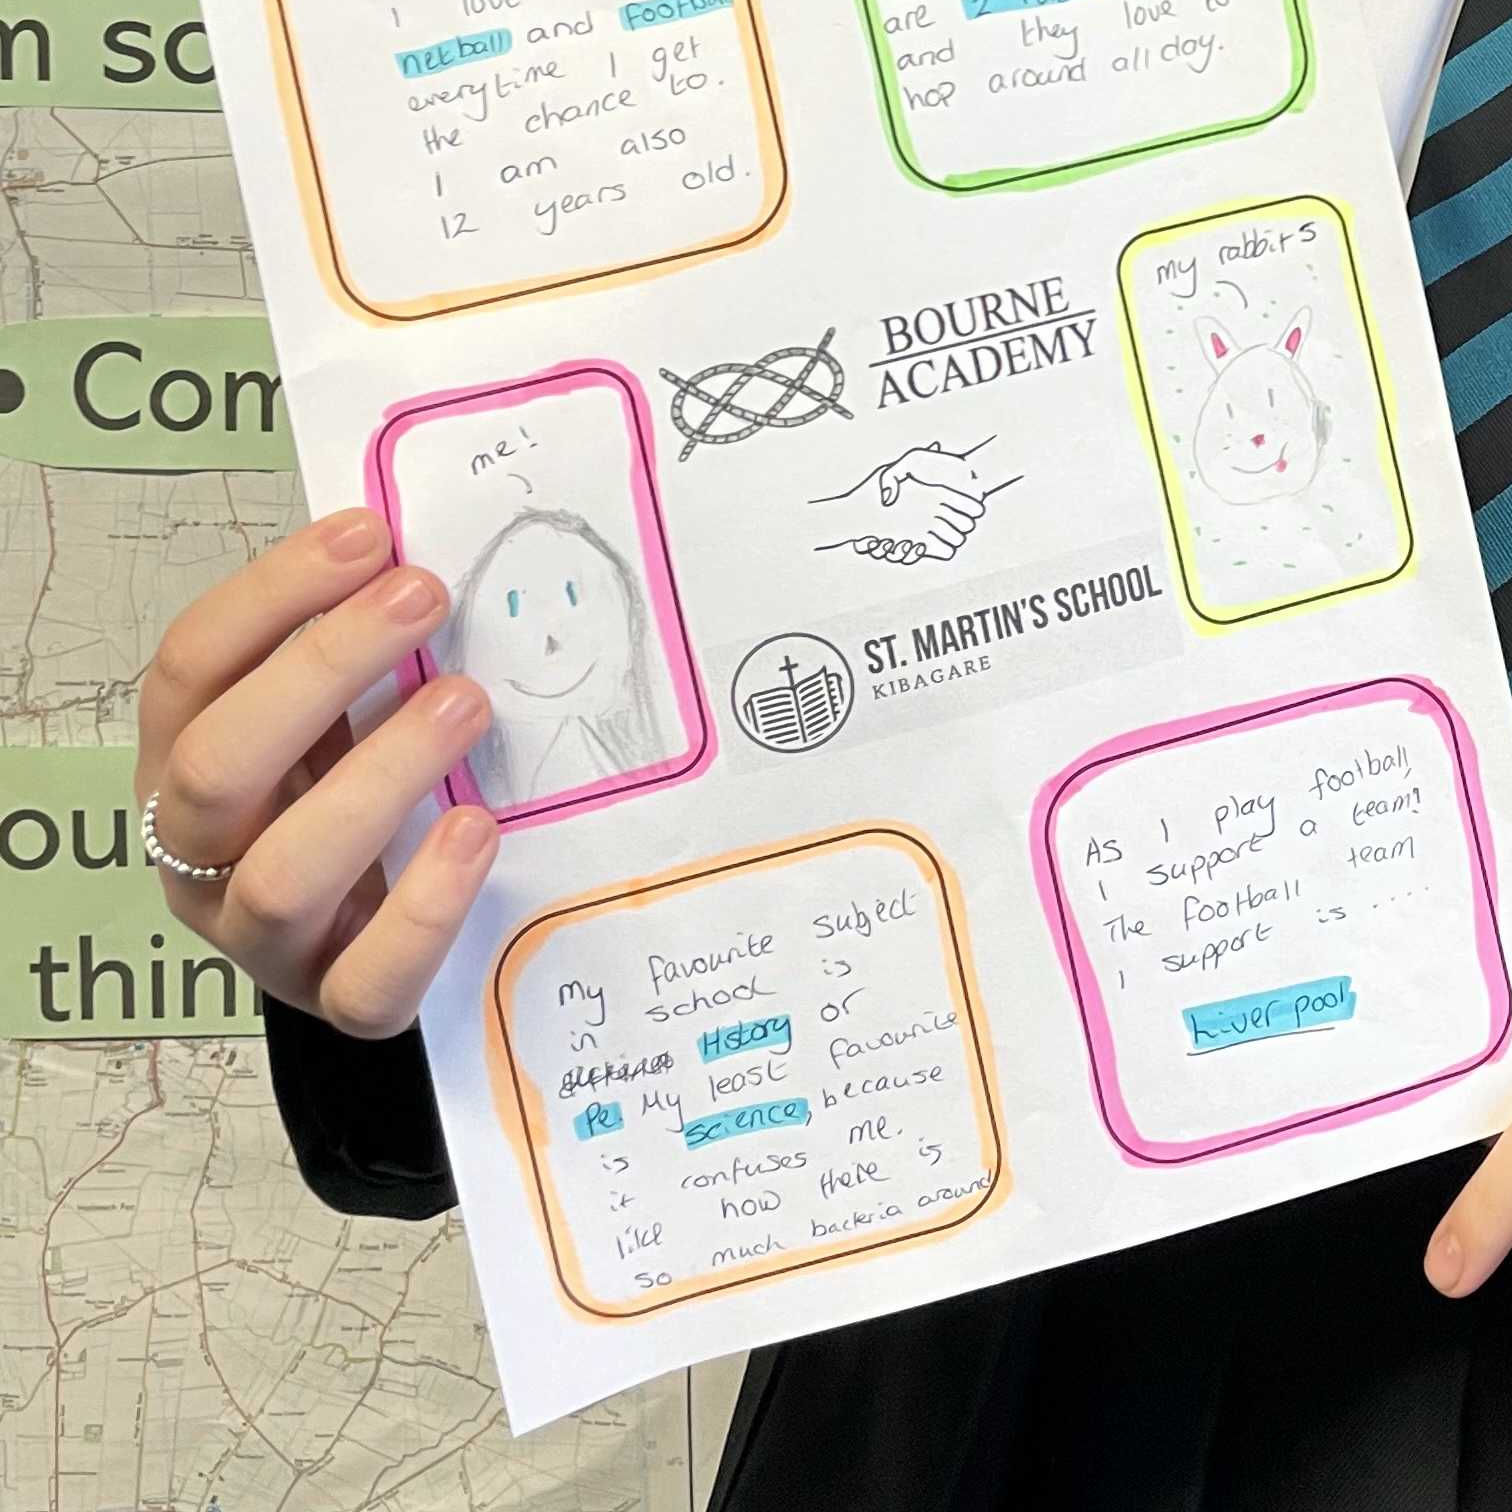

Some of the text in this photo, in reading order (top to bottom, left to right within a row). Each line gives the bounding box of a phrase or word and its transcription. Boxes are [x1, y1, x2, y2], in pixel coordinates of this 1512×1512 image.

[400, 33, 503, 75] netball
[526, 11, 594, 44] and
[883, 3, 936, 34] are
[896, 38, 956, 71] and
[1020, 18, 1079, 60] they
[1124, 0, 1177, 30] love
[652, 35, 702, 82] get
[904, 82, 956, 110] hop
[988, 58, 1088, 94] around
[1112, 48, 1150, 72] all
[424, 127, 464, 155] the
[525, 89, 637, 134] chance
[500, 156, 557, 184] am
[620, 127, 686, 156] also
[440, 212, 479, 240] 12
[534, 182, 627, 236] years
[1156, 221, 1317, 299] my rabbits
[880, 276, 1071, 355] BOURNE
[877, 317, 1098, 409] ACADEMY
[470, 426, 538, 476] me!
[863, 563, 1164, 675] ST. MARTIN'S SCHOOL
[871, 654, 993, 701] KIBAGARE
[0, 809, 155, 870] ou
[1214, 794, 1276, 837] play
[1146, 832, 1265, 887] support
[1300, 818, 1317, 837] a
[1102, 835, 1416, 942] The football team
[647, 932, 776, 996] favourite
[812, 890, 918, 939] subject
[1161, 923, 1273, 973] support
[1316, 905, 1347, 924] is
[570, 957, 853, 1052] in school is
[820, 987, 865, 1023] or
[709, 1059, 791, 1101] least
[828, 1010, 959, 1069] favourite
[600, 1154, 631, 1172] is
[822, 1066, 944, 1109] because
[609, 1192, 636, 1213] it
[680, 1151, 808, 1190] confuses
[616, 1136, 943, 1259] like how there is
[634, 1169, 993, 1289] so much bacteria around
